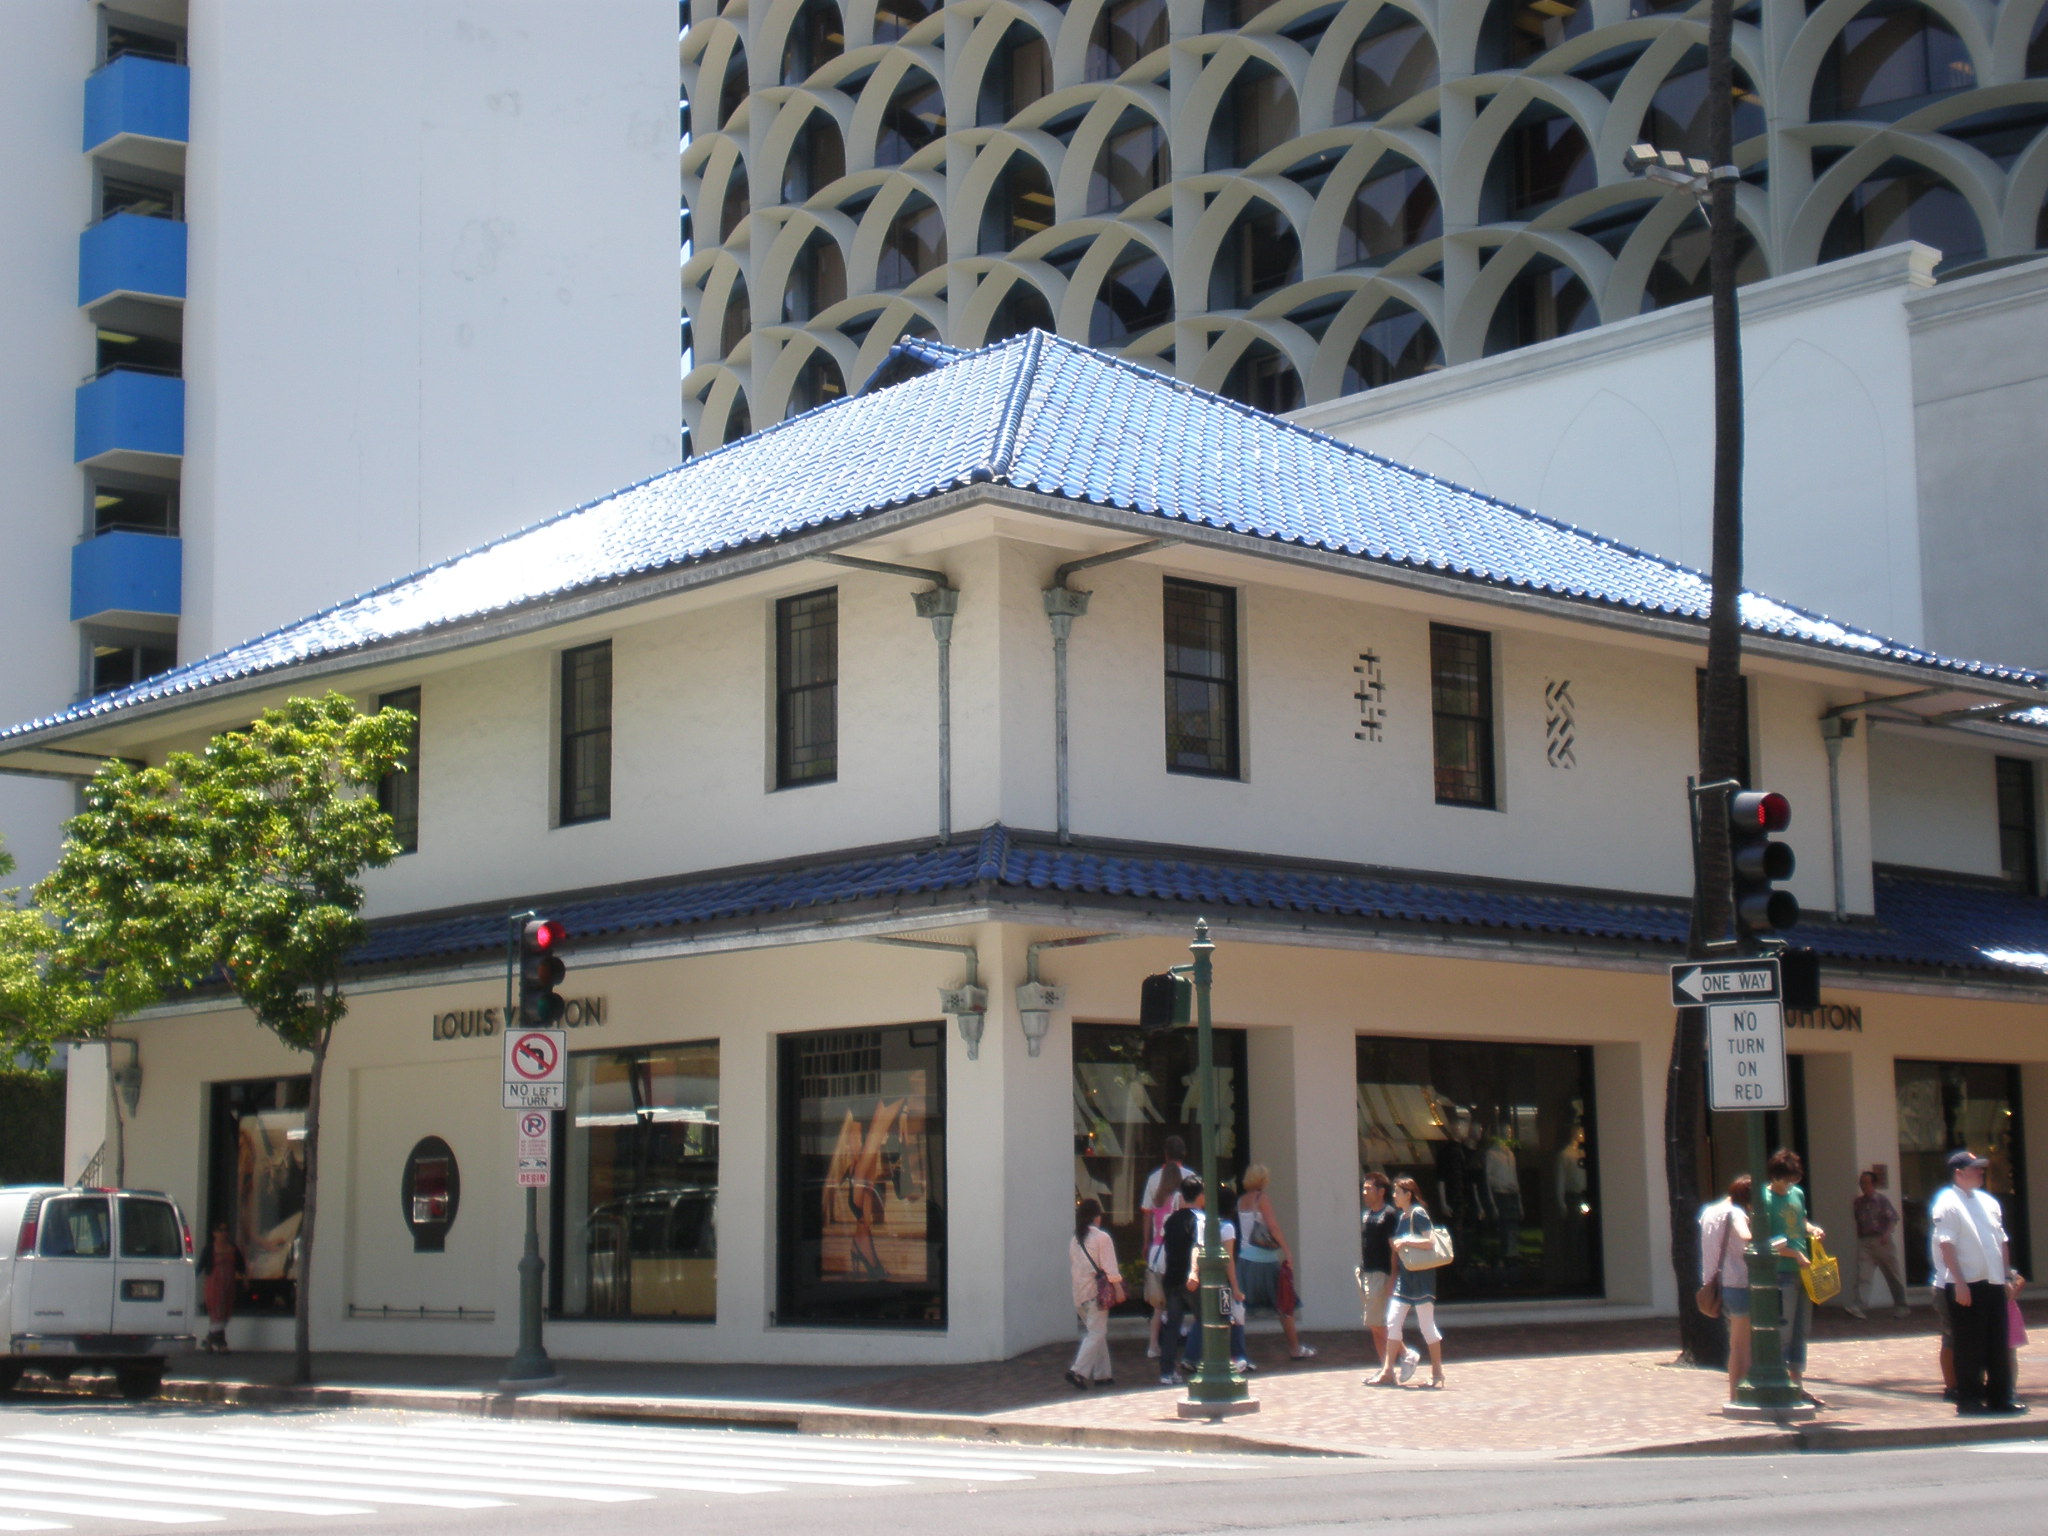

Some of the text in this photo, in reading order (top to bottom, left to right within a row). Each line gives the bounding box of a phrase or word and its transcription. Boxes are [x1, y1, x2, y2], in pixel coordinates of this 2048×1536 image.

[1702, 973, 1767, 992] ONE WAY
[432, 1008, 495, 1041] LOUIS
[1733, 1010, 1757, 1032] NO
[1783, 1004, 1863, 1032] UITON
[1727, 1037, 1765, 1055] TURN
[1737, 1060, 1758, 1077] ON
[510, 1083, 559, 1097] NO LEFT
[1734, 1083, 1763, 1100] RED
[520, 1096, 548, 1106] TURN
[520, 1173, 546, 1183] BEGIN
